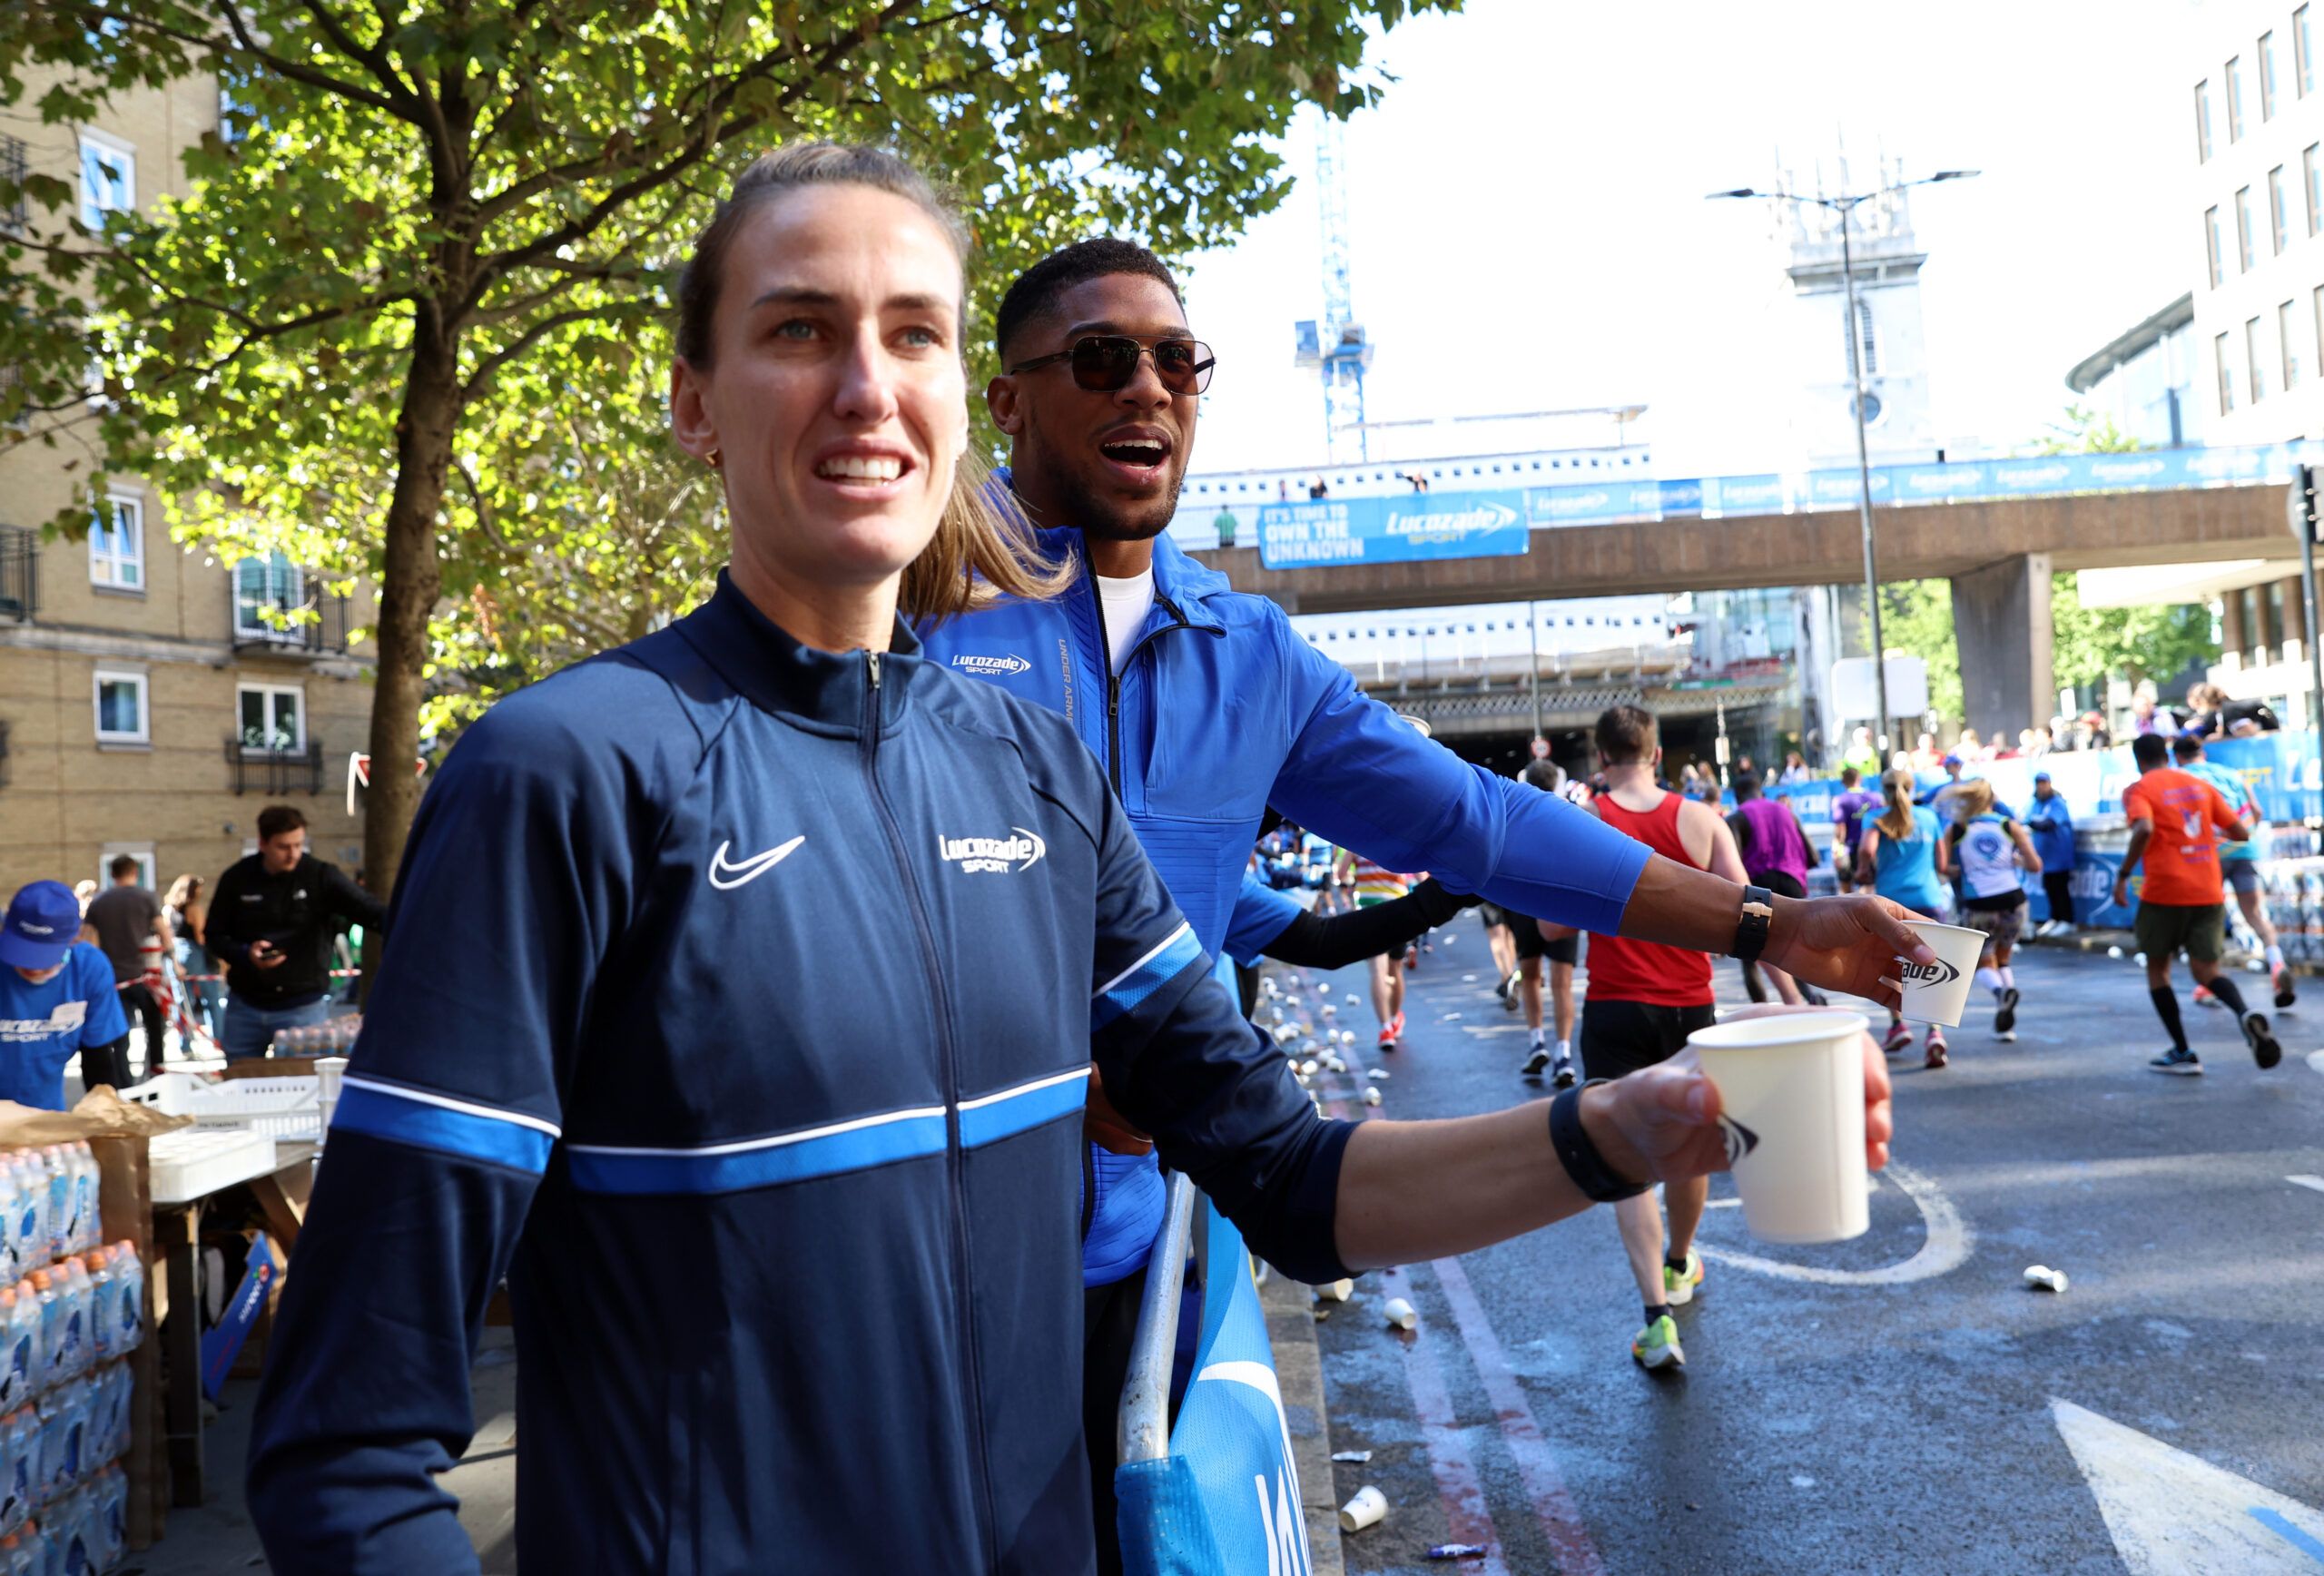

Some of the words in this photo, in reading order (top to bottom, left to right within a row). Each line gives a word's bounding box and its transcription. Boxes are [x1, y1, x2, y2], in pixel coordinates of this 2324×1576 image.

[1264, 507, 1290, 524] IT'S
[1329, 503, 1348, 519] TO
[1385, 506, 1497, 536] Lucozade
[1265, 522, 1309, 542] OWN
[1313, 518, 1349, 540] THE
[1266, 537, 1364, 563] UNKNOWN
[951, 654, 1019, 670] Lucozade
[965, 665, 1002, 675] SPORT
[1059, 638, 1071, 684] UNDER
[938, 833, 1033, 861] Lucozade
[961, 859, 1009, 873] SPORT
